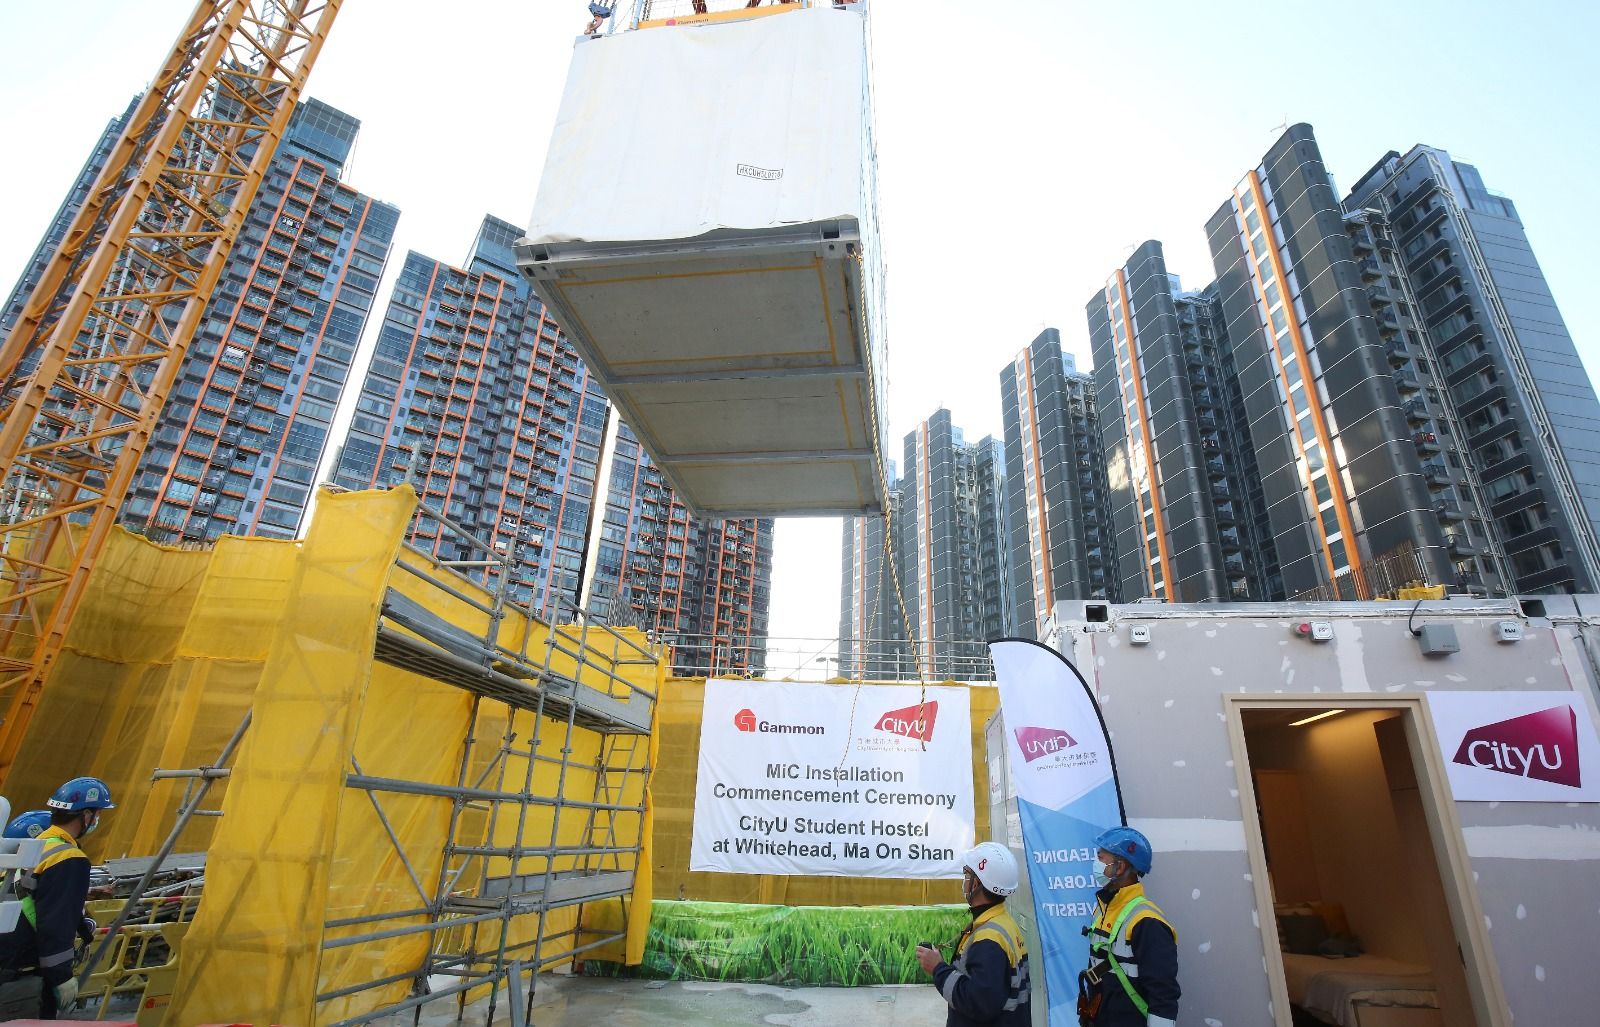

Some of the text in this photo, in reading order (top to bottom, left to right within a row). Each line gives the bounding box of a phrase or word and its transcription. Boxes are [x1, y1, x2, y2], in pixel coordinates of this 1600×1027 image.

[759, 720, 825, 735] Gammon
[881, 717, 927, 737] CityU
[1467, 740, 1562, 778] CityU
[766, 763, 904, 782] MiC Installation
[713, 783, 956, 809] Commencement Ceremony
[739, 815, 929, 837] CityU Student Hostel
[712, 838, 954, 861] at Whitehead, Ma On Shan
